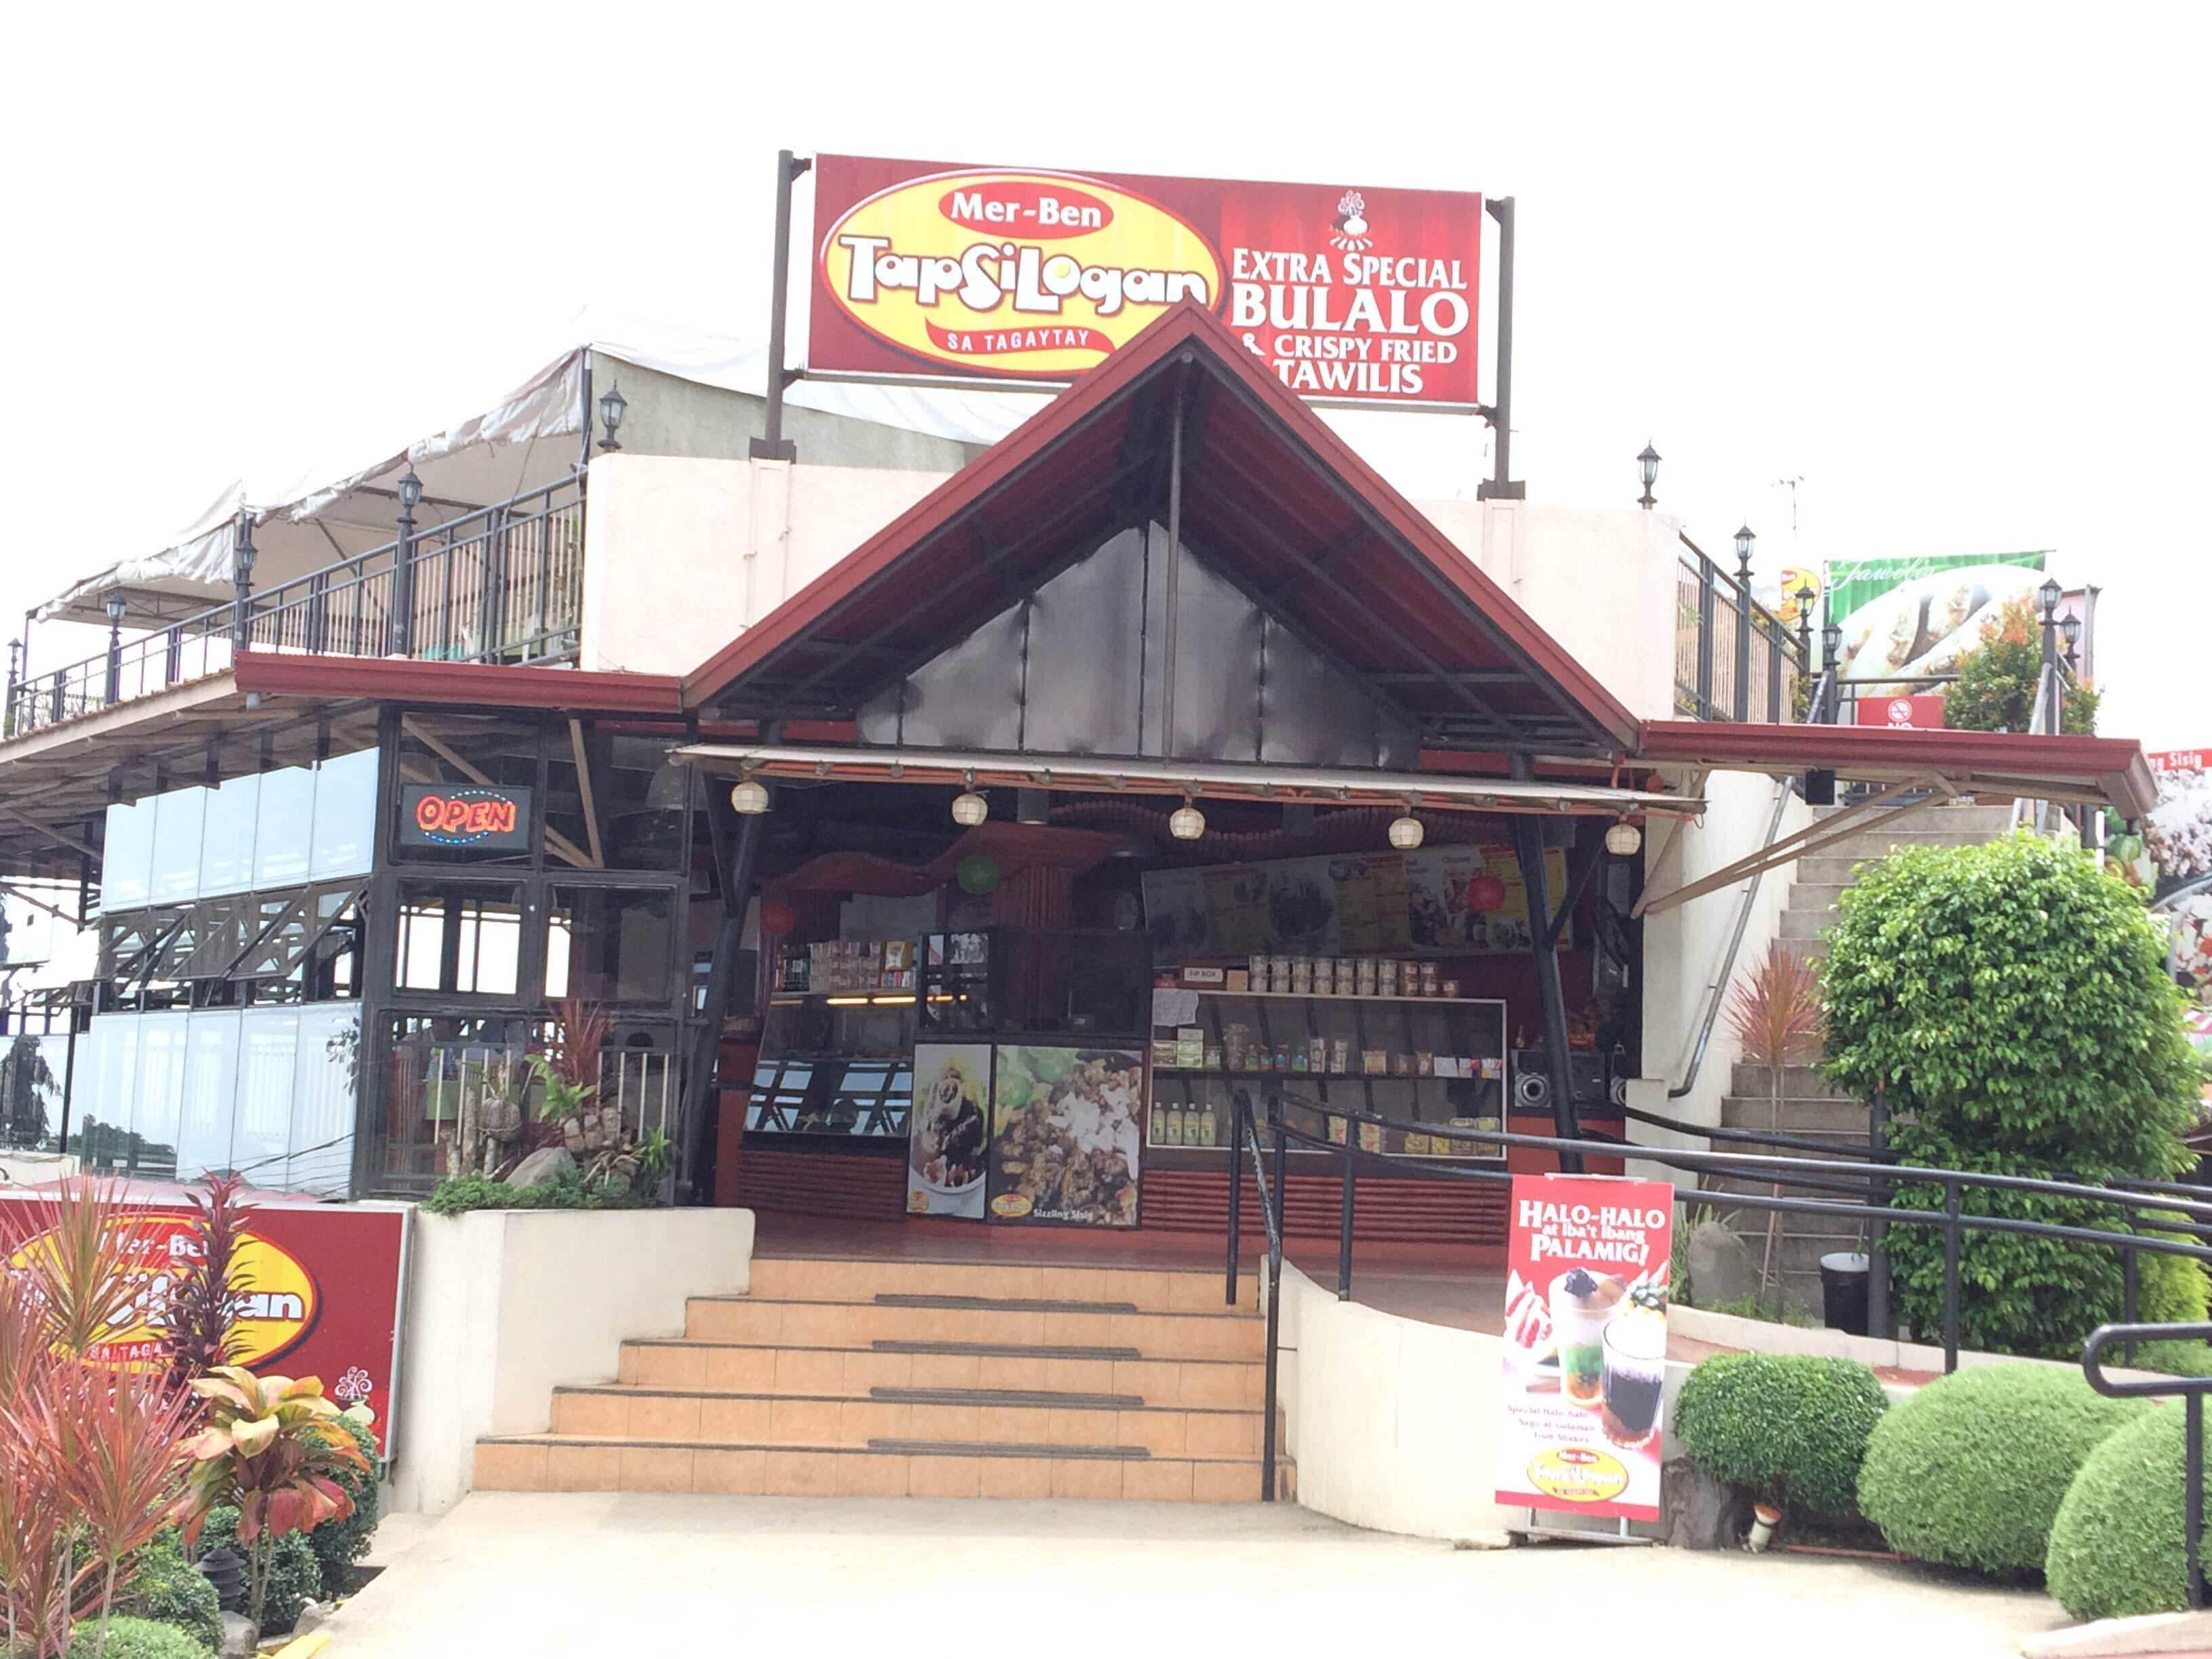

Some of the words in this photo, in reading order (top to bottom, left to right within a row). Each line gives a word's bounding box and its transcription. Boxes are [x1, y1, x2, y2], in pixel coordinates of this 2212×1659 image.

[951, 191, 1102, 228] Mer-Ben
[839, 235, 1207, 316] TapSiLogan
[1233, 248, 1332, 283] EXTRA
[1343, 252, 1467, 289] SPECIAL
[1231, 282, 1469, 337] BULALO
[947, 332, 974, 351] SA
[984, 329, 1090, 351] TAGAYTAY
[1274, 334, 1372, 361] CRISPY
[1381, 340, 1457, 364] FRIED
[1273, 359, 1423, 394] TAWILIS
[417, 795, 516, 832] OPEN
[1519, 1200, 1666, 1229] HALO-HALO
[1542, 1223, 1558, 1235] at
[1530, 1234, 1650, 1266] PALAMIG!
